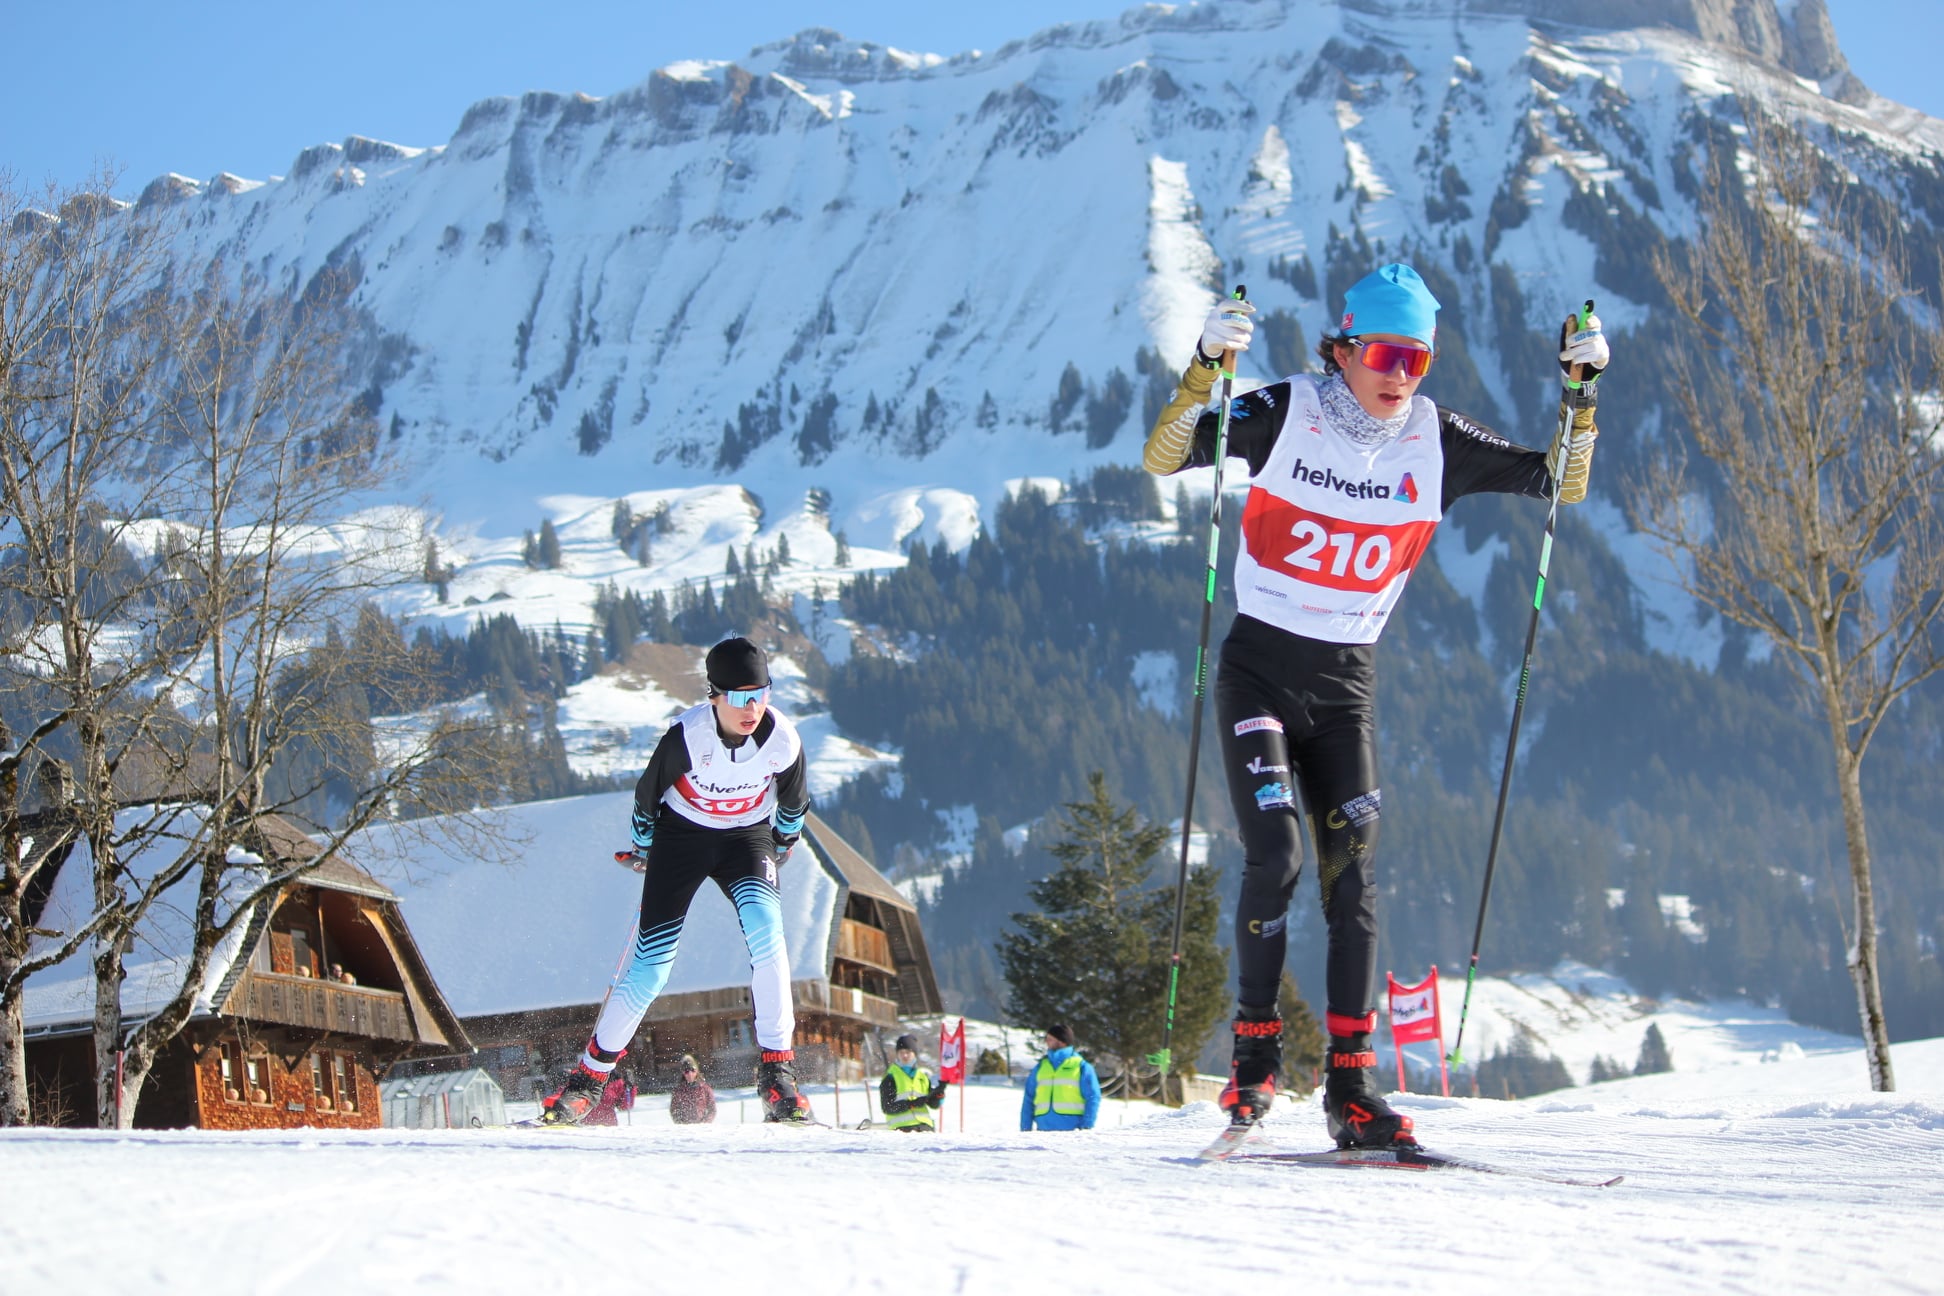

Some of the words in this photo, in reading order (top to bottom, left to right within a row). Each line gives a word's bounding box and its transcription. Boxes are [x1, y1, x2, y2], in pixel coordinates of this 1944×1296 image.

[1291, 457, 1391, 501] helvetia
[1282, 519, 1392, 581] 210
[1254, 585, 1288, 600] swisscom
[690, 774, 760, 794] helvetia
